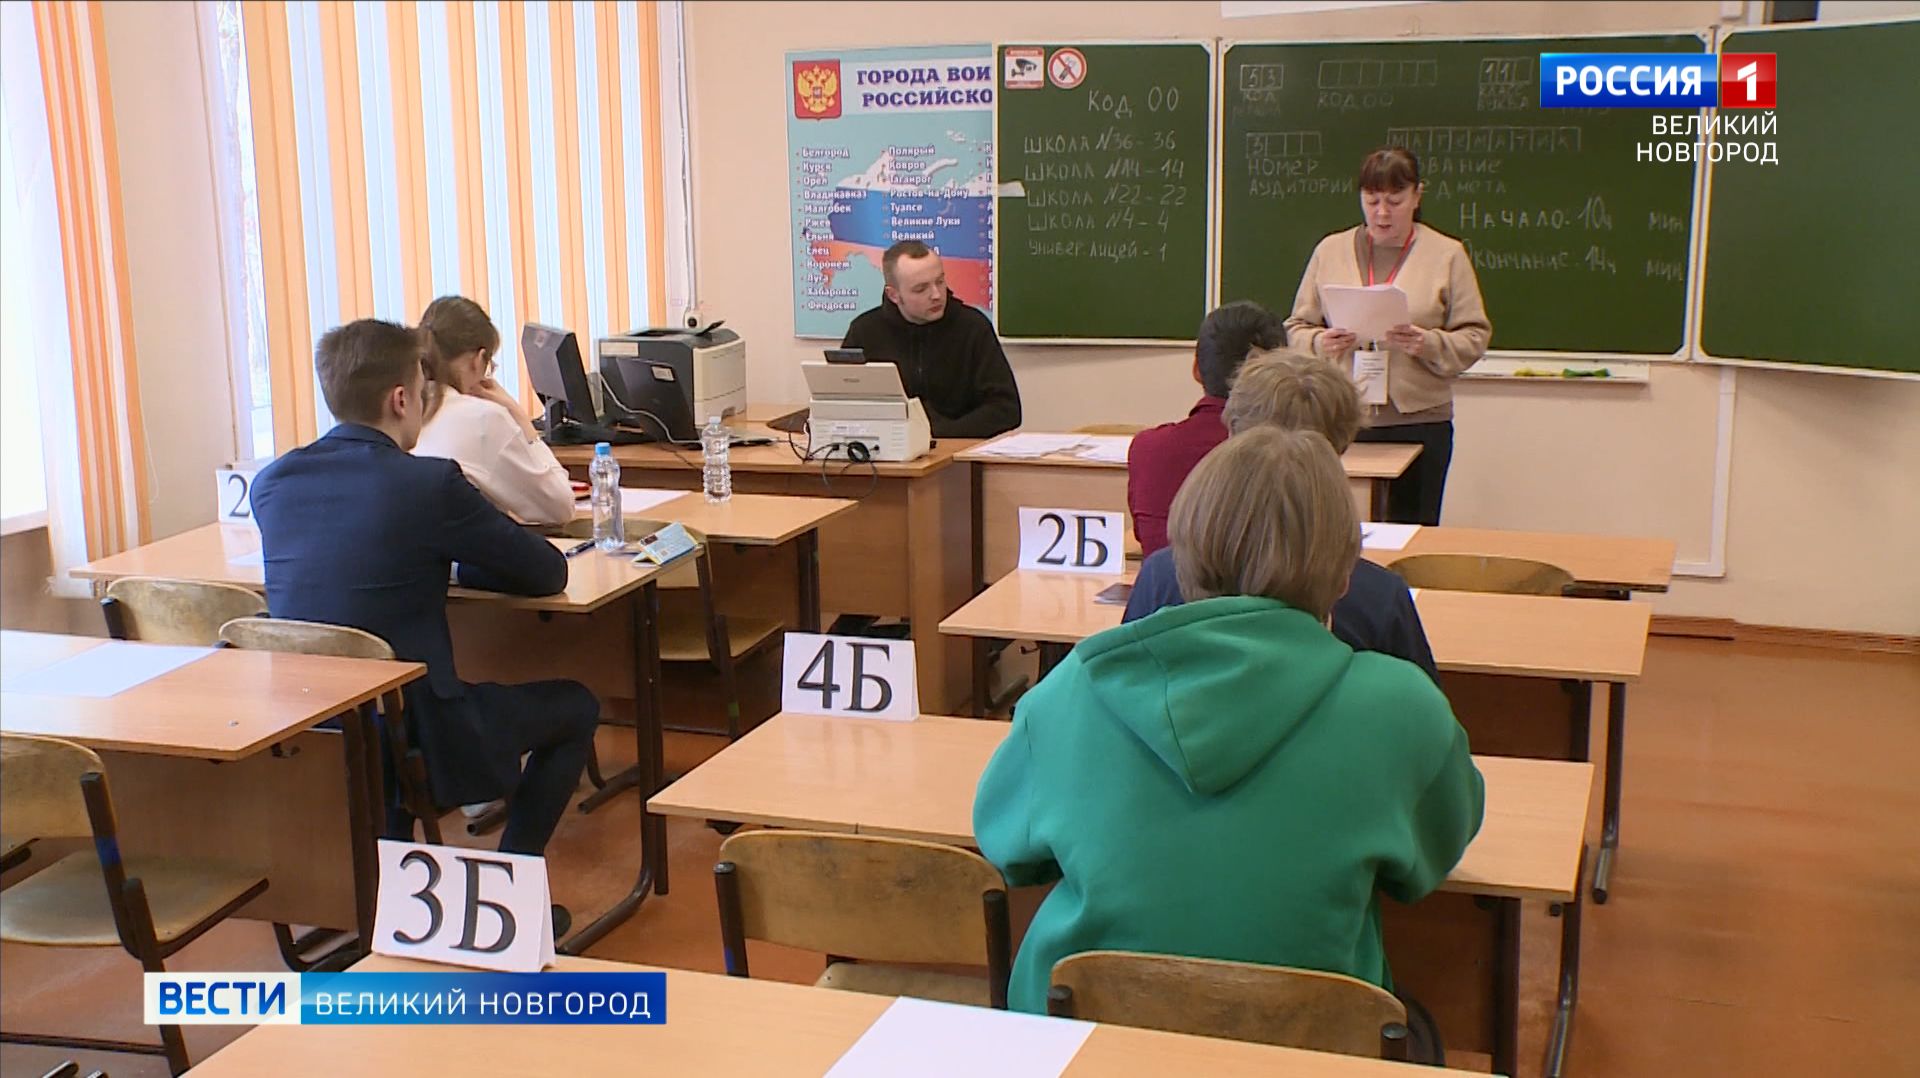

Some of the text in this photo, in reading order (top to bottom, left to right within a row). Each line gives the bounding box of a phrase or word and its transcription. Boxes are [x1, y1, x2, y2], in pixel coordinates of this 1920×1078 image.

[857, 66, 991, 86] ГОРОДА ВОИ
[862, 87, 992, 107] РОССИЙСКО
[1153, 129, 1176, 150] 36
[803, 148, 849, 159] Белгород
[803, 163, 831, 174] Курск
[889, 161, 925, 172] Ковров
[1161, 158, 1184, 179] 14
[890, 175, 931, 186] Таганрог
[804, 190, 866, 200] Владикавказ
[890, 188, 970, 199] Ростов-на-Дону
[1160, 184, 1187, 206] 22
[805, 204, 851, 215] Малгобек
[891, 203, 923, 214] Туапсе
[806, 219, 830, 229] Ржев
[892, 217, 961, 229] Великие Луки
[1157, 209, 1169, 233] 4
[892, 231, 935, 242] Великий
[807, 247, 829, 257] Елец
[1159, 242, 1168, 263] 1
[808, 274, 829, 284] Луга
[1037, 512, 1108, 567] 2Б
[797, 640, 892, 713] 4Б
[393, 850, 516, 953] 3Б
